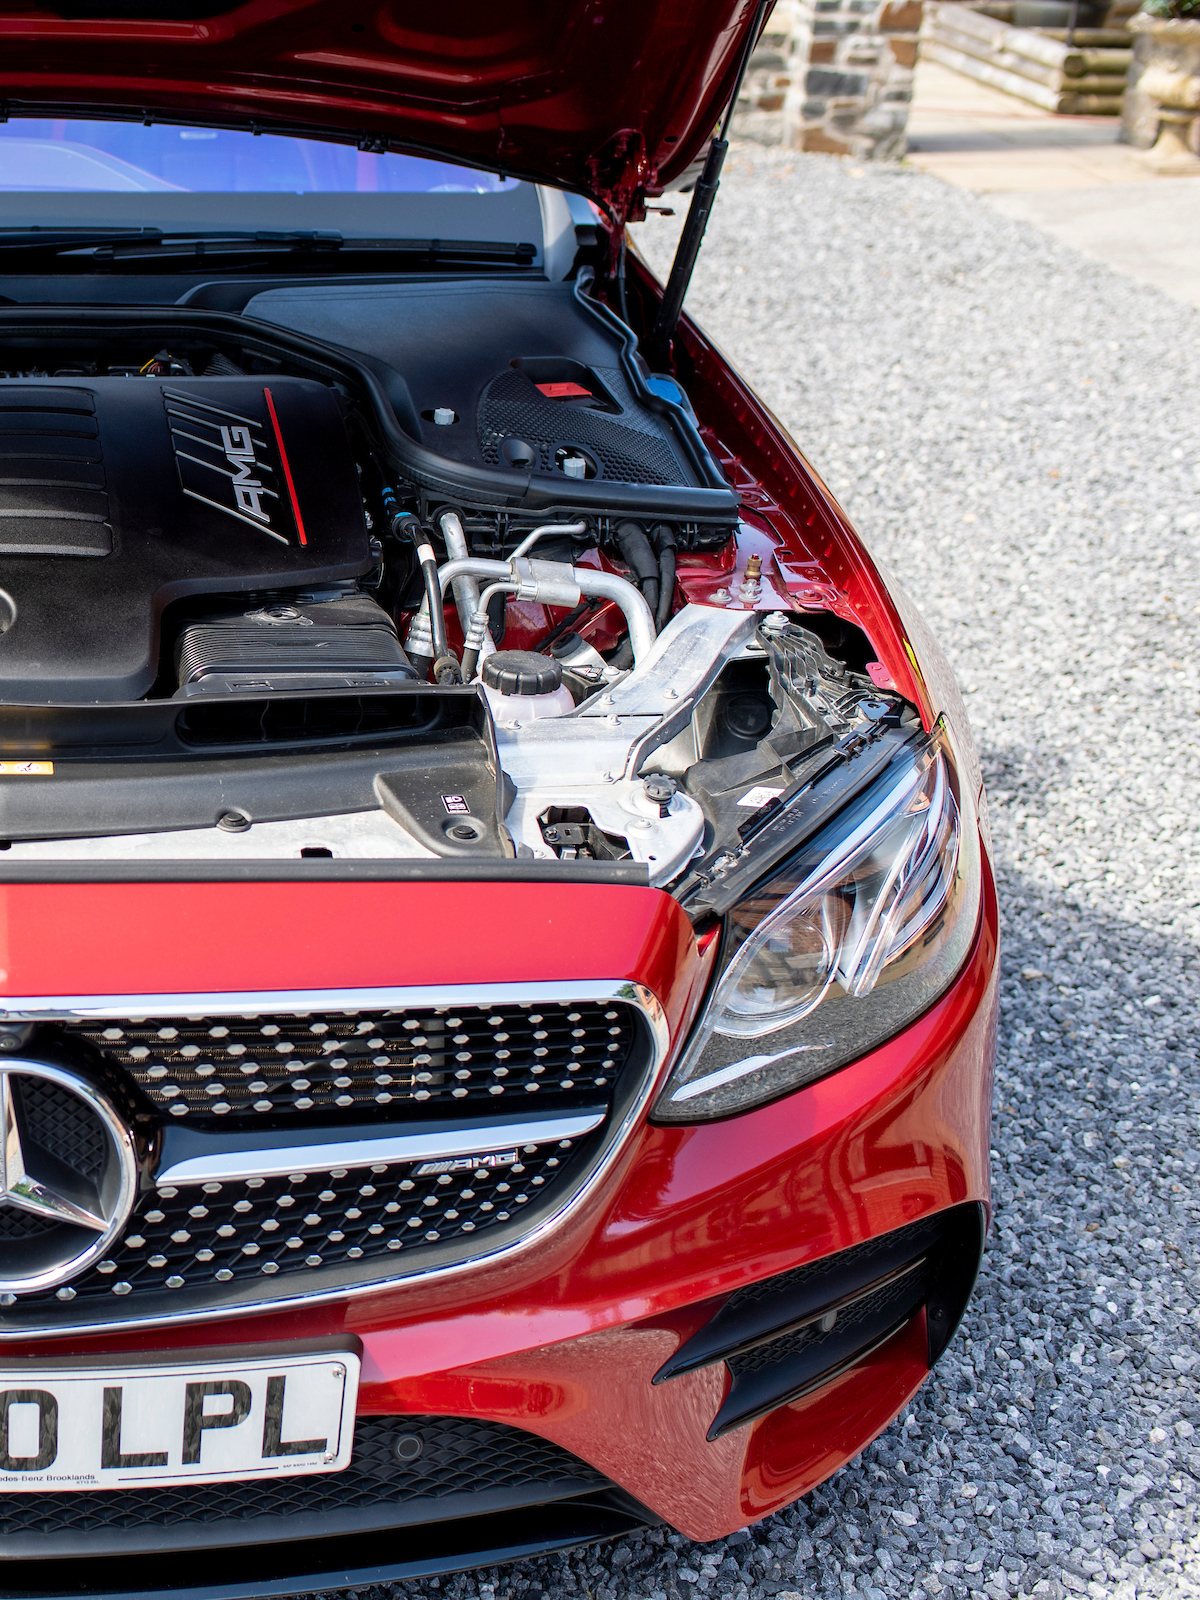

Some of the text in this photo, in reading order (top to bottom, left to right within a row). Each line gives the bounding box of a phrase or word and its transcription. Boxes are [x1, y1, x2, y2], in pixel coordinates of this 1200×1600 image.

[220, 425, 271, 523] AMG
[449, 1152, 517, 1170] AMG
[101, 1376, 328, 1470] LPL
